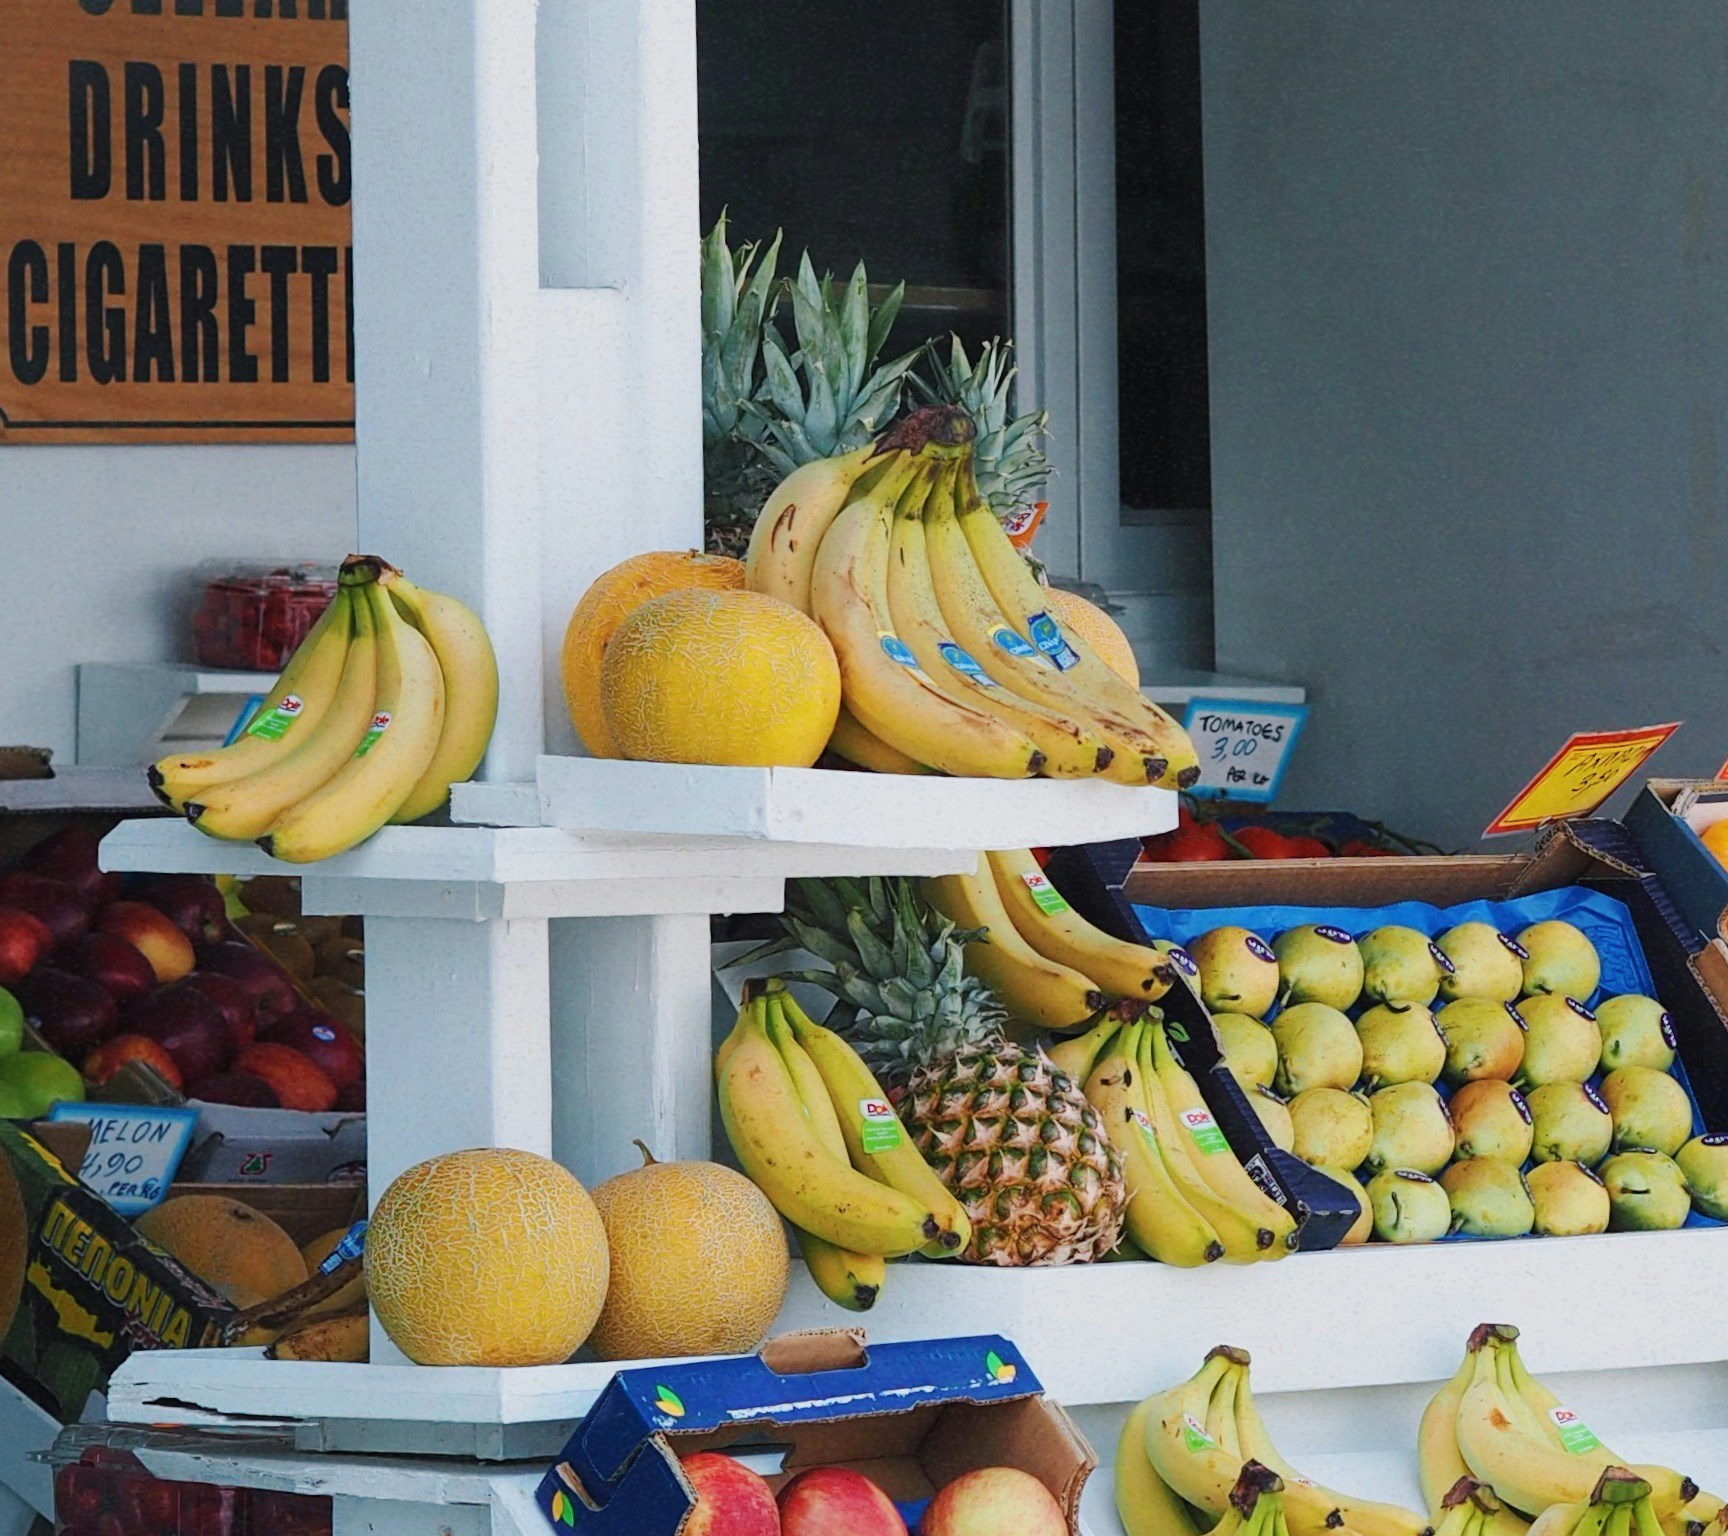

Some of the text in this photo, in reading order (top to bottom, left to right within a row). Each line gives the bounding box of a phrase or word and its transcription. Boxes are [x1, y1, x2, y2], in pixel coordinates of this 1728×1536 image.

[68, 60, 352, 207] DRINKS
[1200, 715, 1284, 743] TOMATOES
[1211, 736, 1257, 762] 3,00
[867, 1103, 888, 1114] Dole
[1187, 1114, 1210, 1125] Dole
[89, 1118, 171, 1145] MELON
[108, 1181, 138, 1197] PER
[42, 1200, 194, 1350] ΠΕΠΟΝΙΑ
